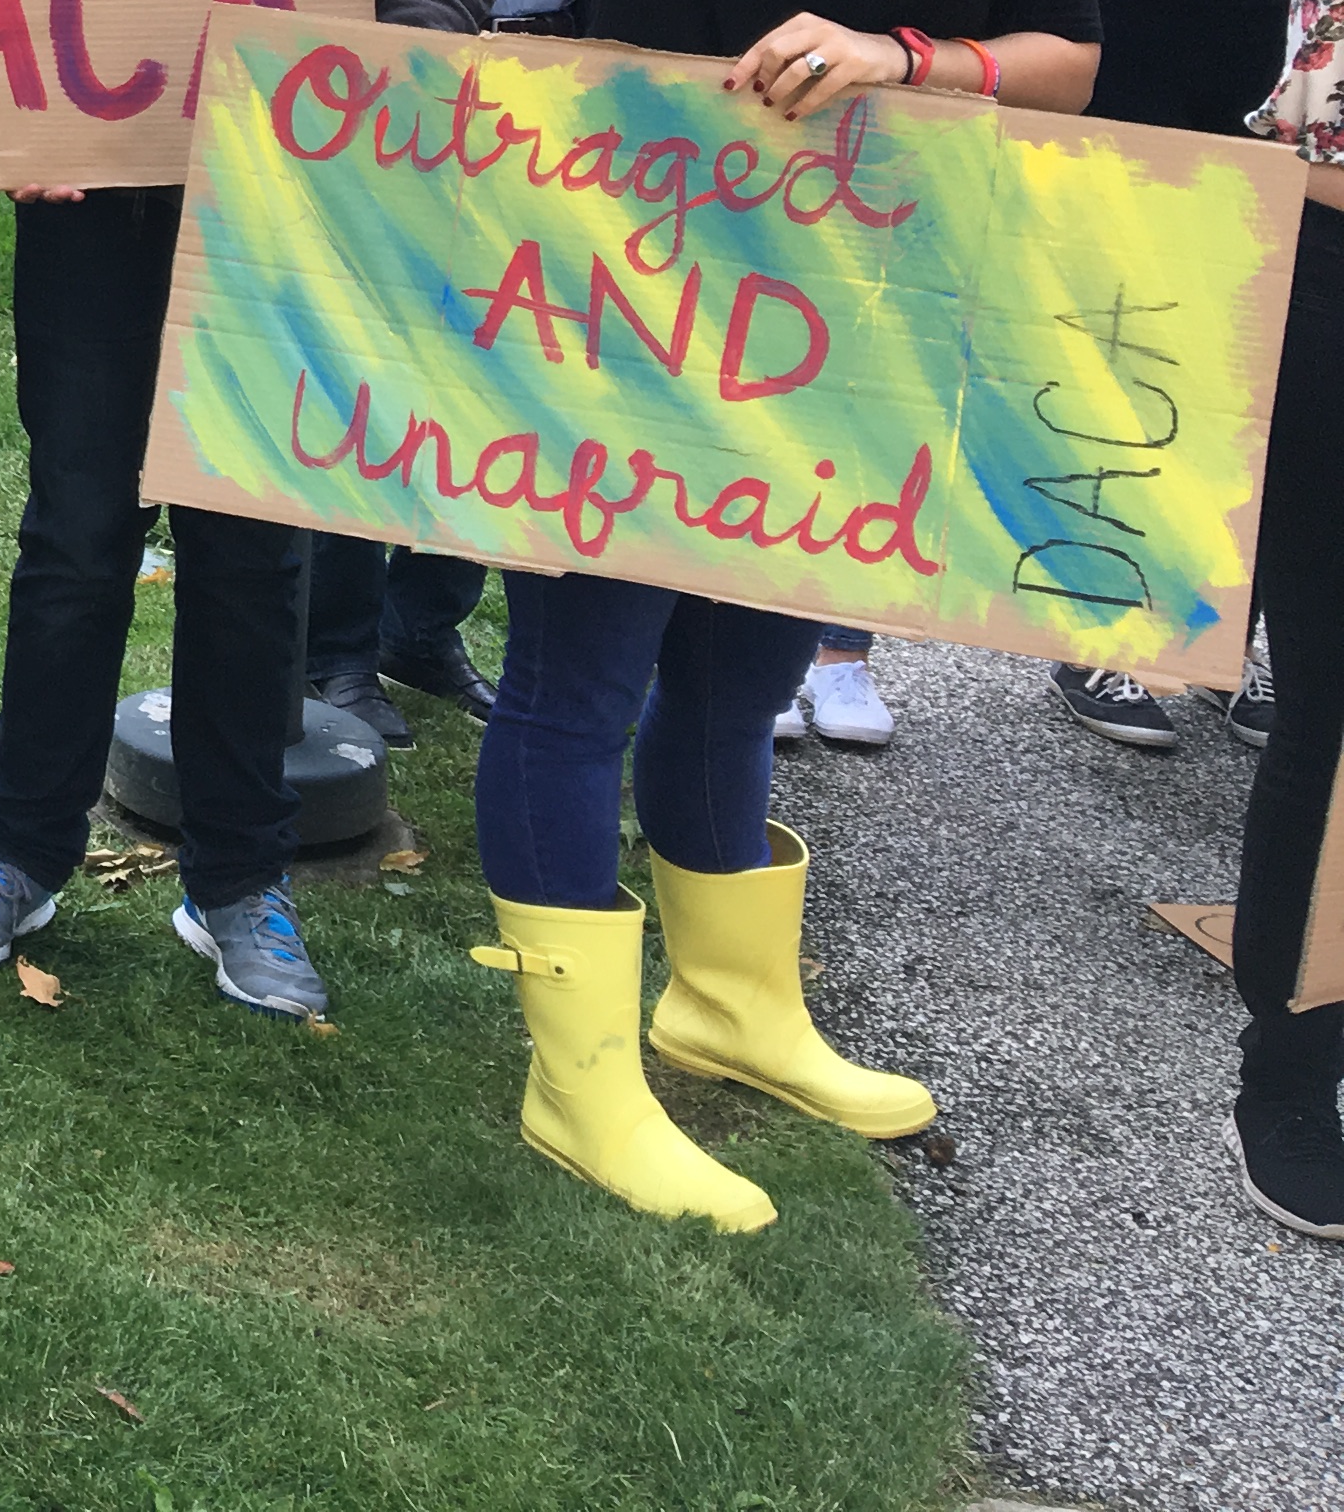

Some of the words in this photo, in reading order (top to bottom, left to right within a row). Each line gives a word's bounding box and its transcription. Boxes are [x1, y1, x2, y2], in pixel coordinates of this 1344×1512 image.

[271, 45, 916, 276] Outraged
[463, 240, 830, 403] AND
[1014, 284, 1180, 611] DACA
